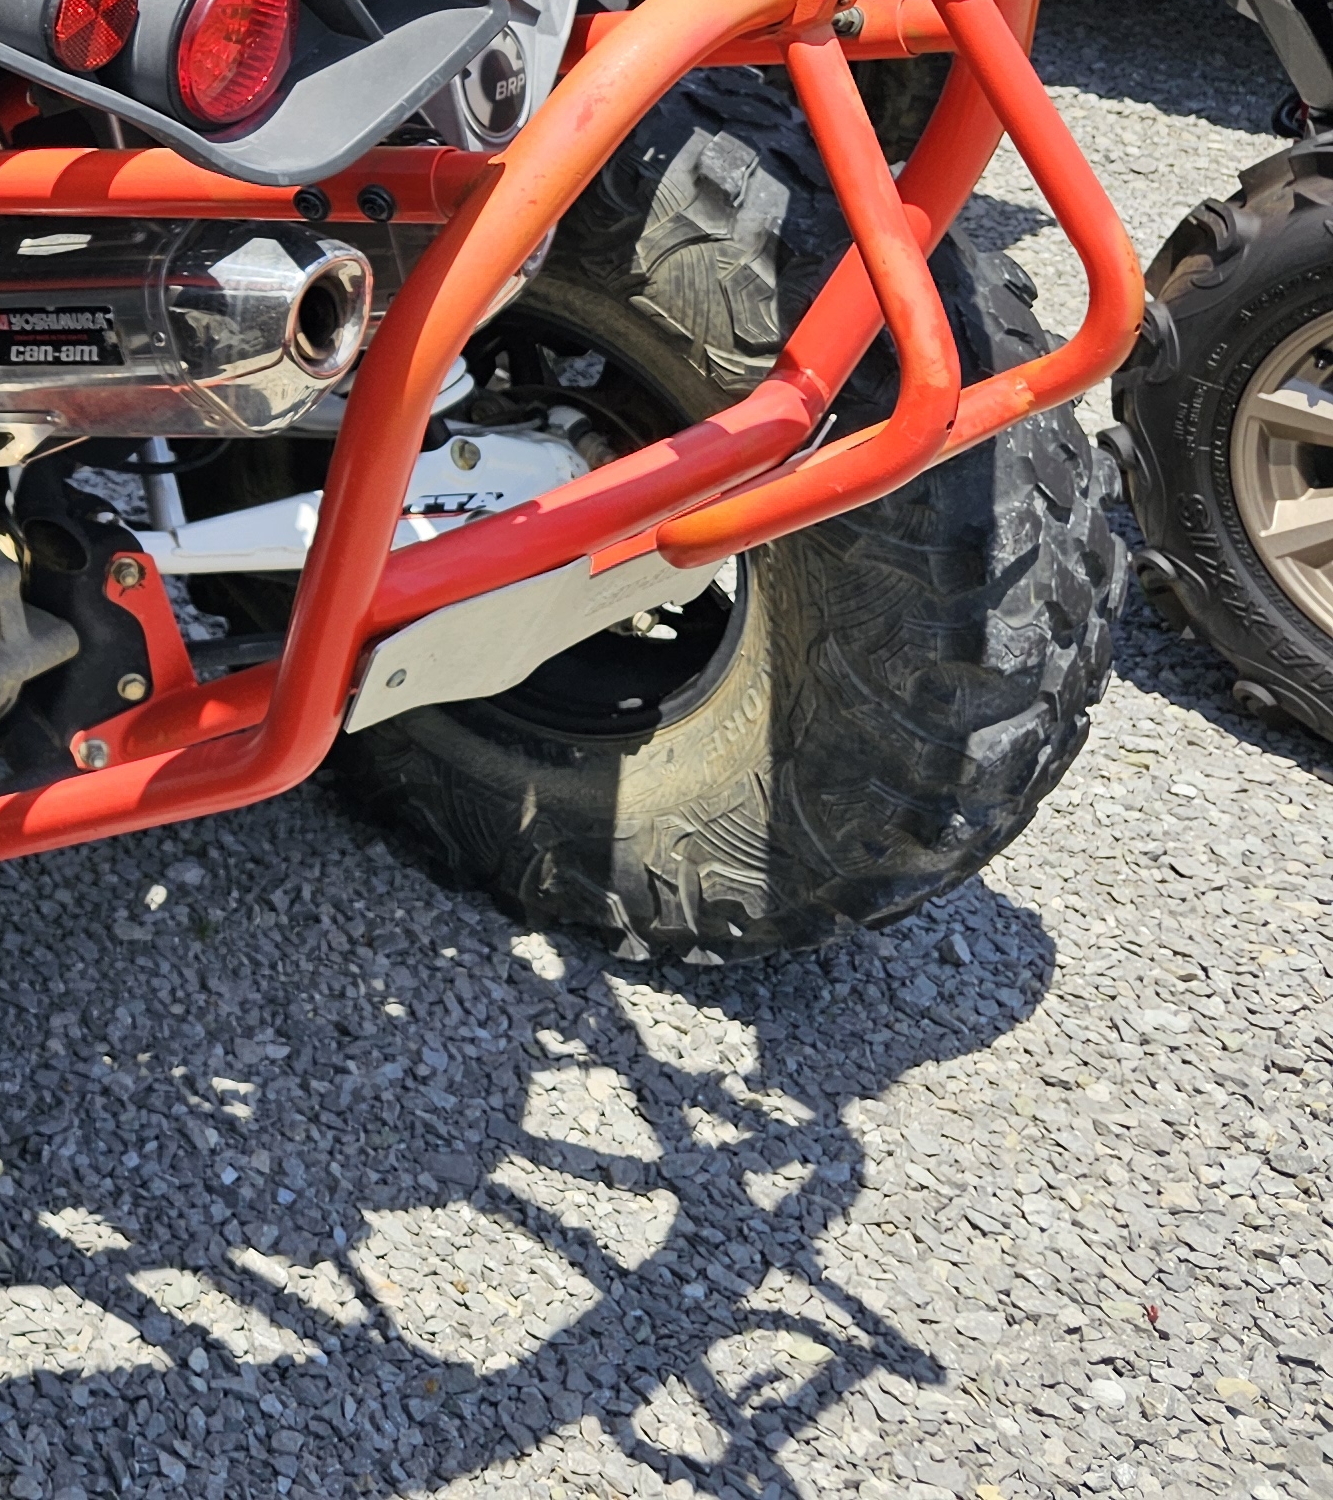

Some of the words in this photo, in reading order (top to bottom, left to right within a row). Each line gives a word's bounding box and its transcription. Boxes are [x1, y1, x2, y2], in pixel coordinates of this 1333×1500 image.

[495, 73, 525, 101] BRP
[11, 312, 108, 331] YOSHIMURA
[10, 344, 100, 363] can-am
